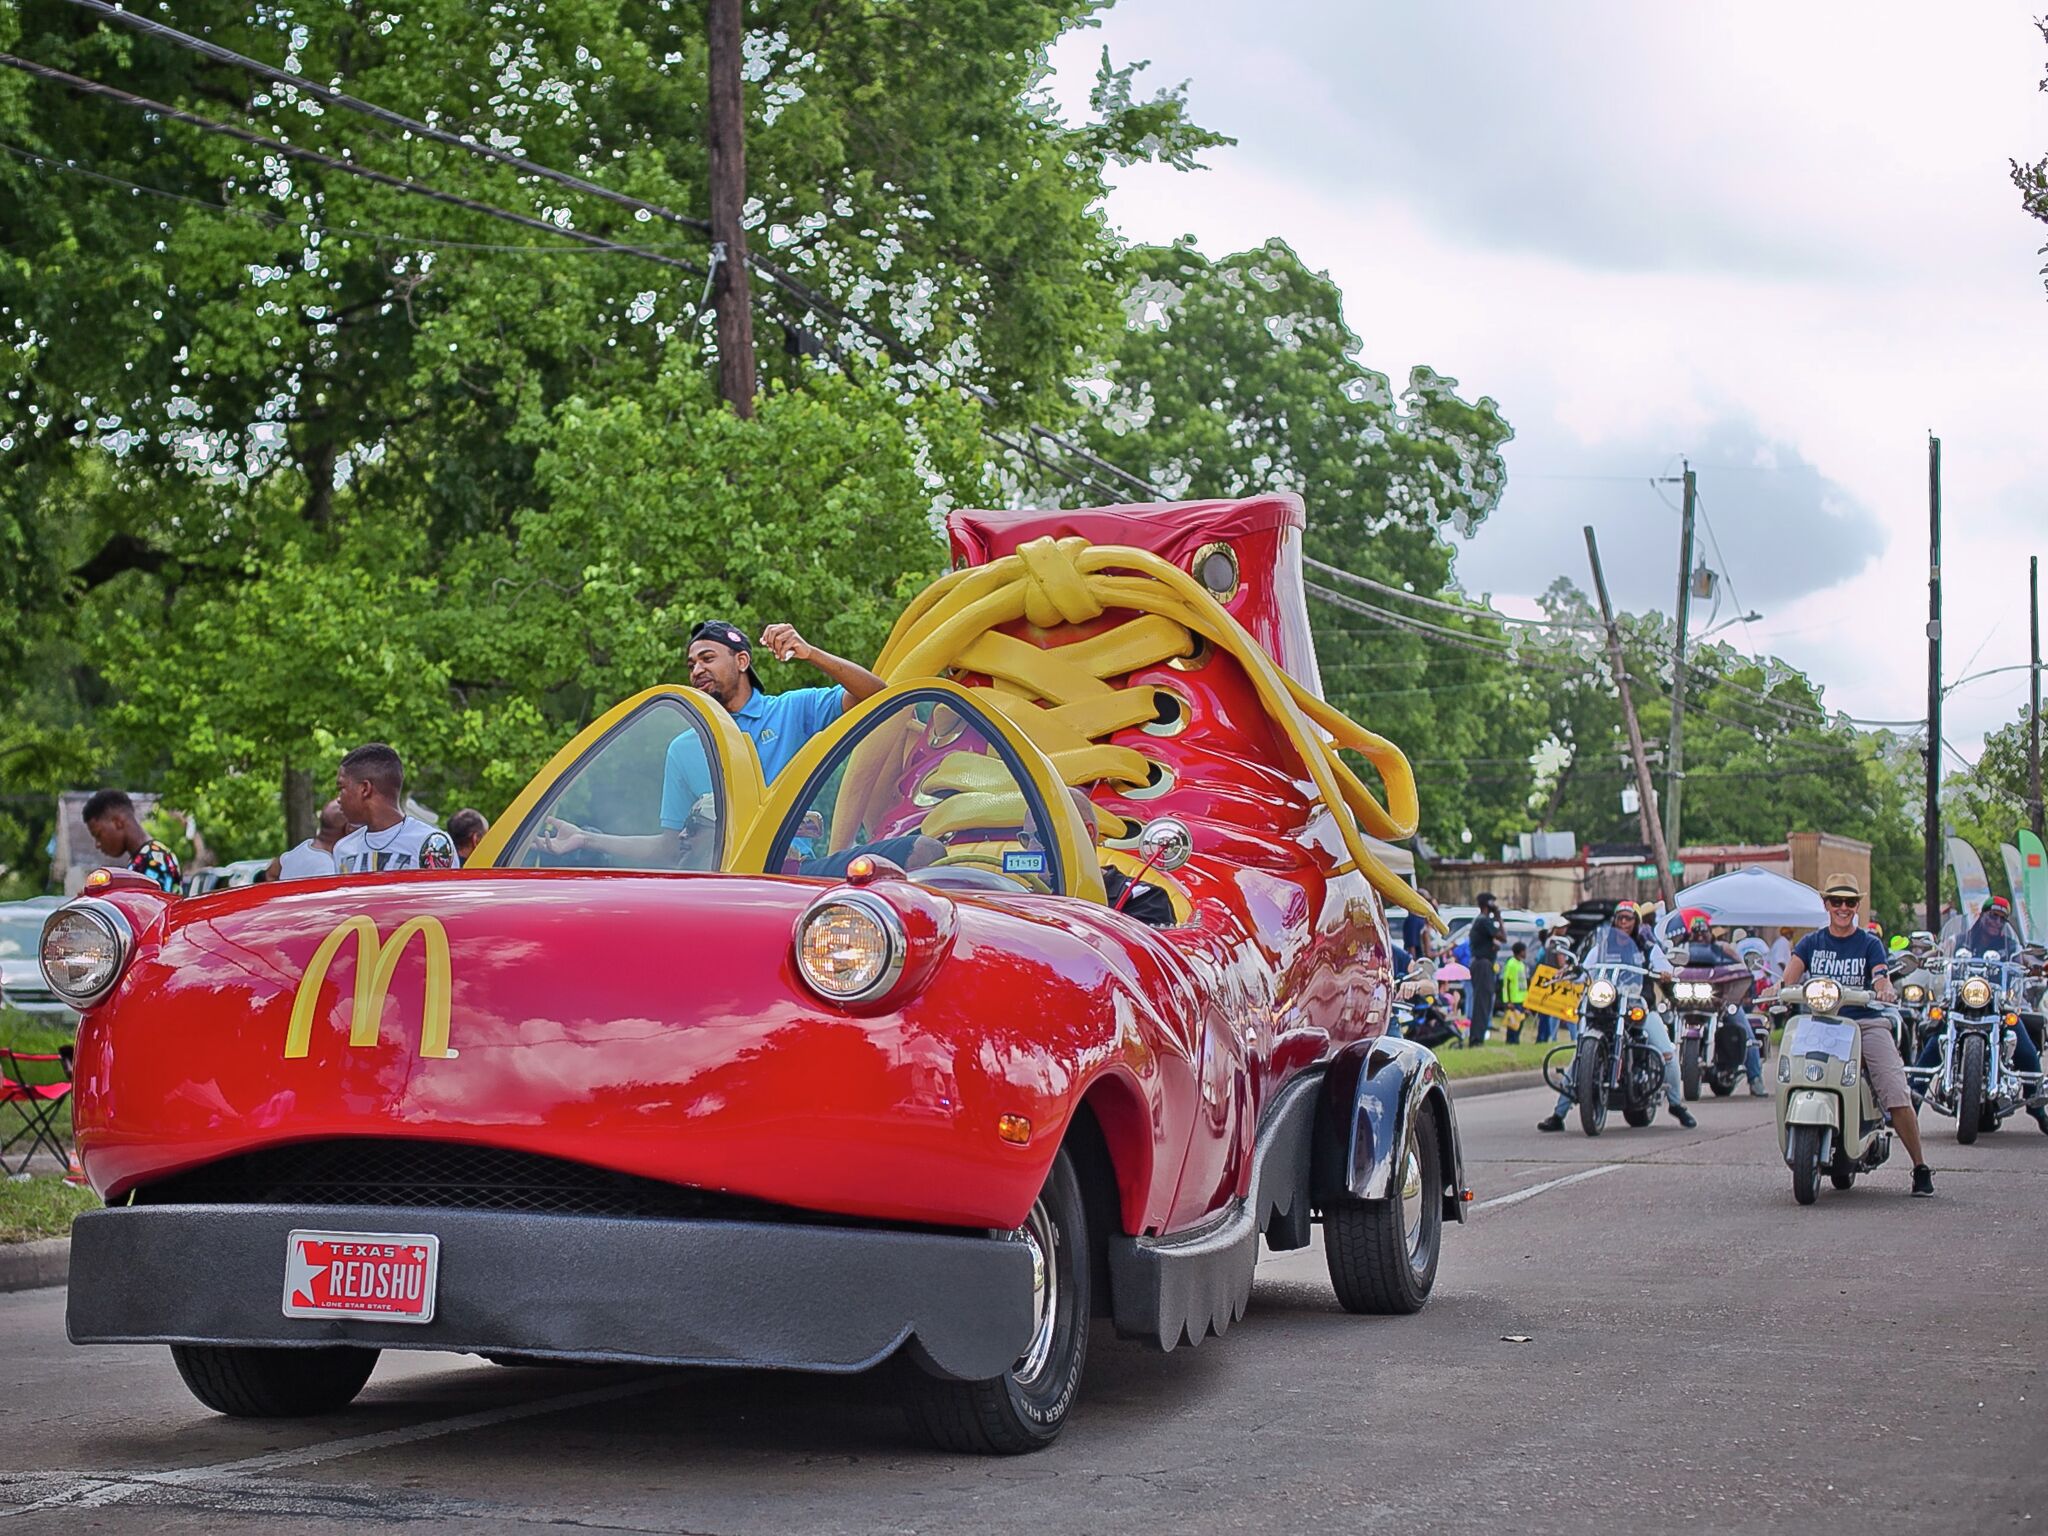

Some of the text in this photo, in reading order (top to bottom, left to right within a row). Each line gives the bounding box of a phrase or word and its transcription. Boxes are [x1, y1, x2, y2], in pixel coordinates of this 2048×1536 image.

[1811, 957, 1866, 976] KENNEDY
[1842, 975, 1865, 985] PEOPLE
[330, 1244, 395, 1258] TEXAS
[329, 1260, 422, 1300] REDSHU
